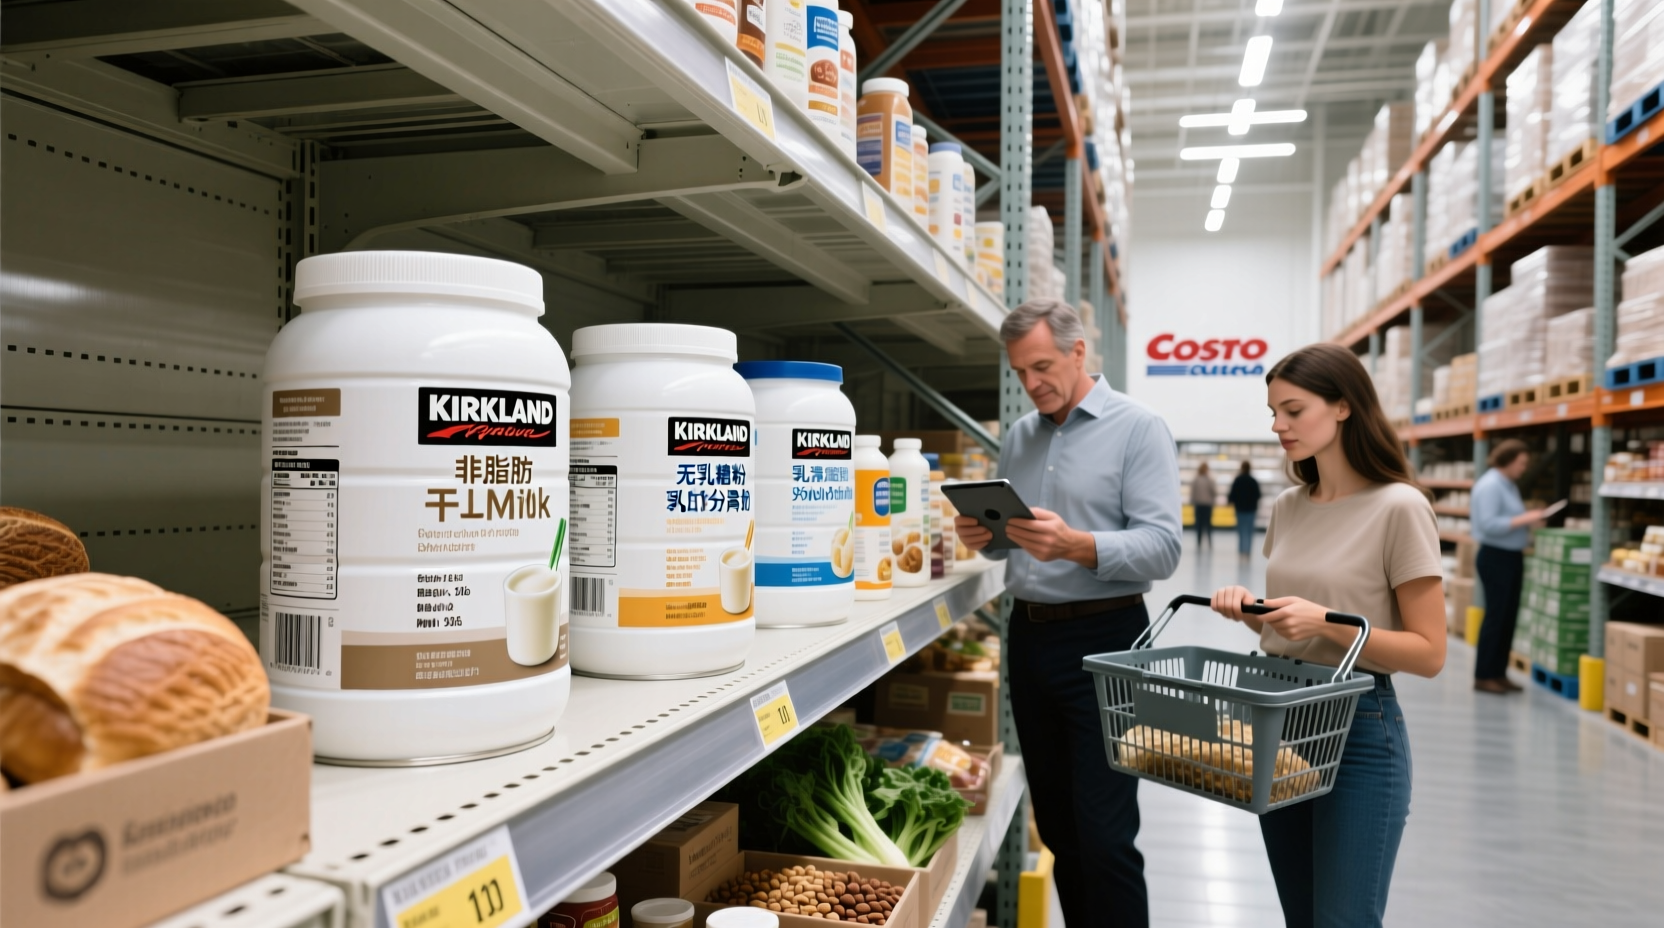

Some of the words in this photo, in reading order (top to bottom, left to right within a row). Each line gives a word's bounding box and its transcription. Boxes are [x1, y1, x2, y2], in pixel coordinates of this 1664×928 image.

[429, 394, 554, 425] KIRKLAND
[455, 454, 533, 484] 非脂肪
